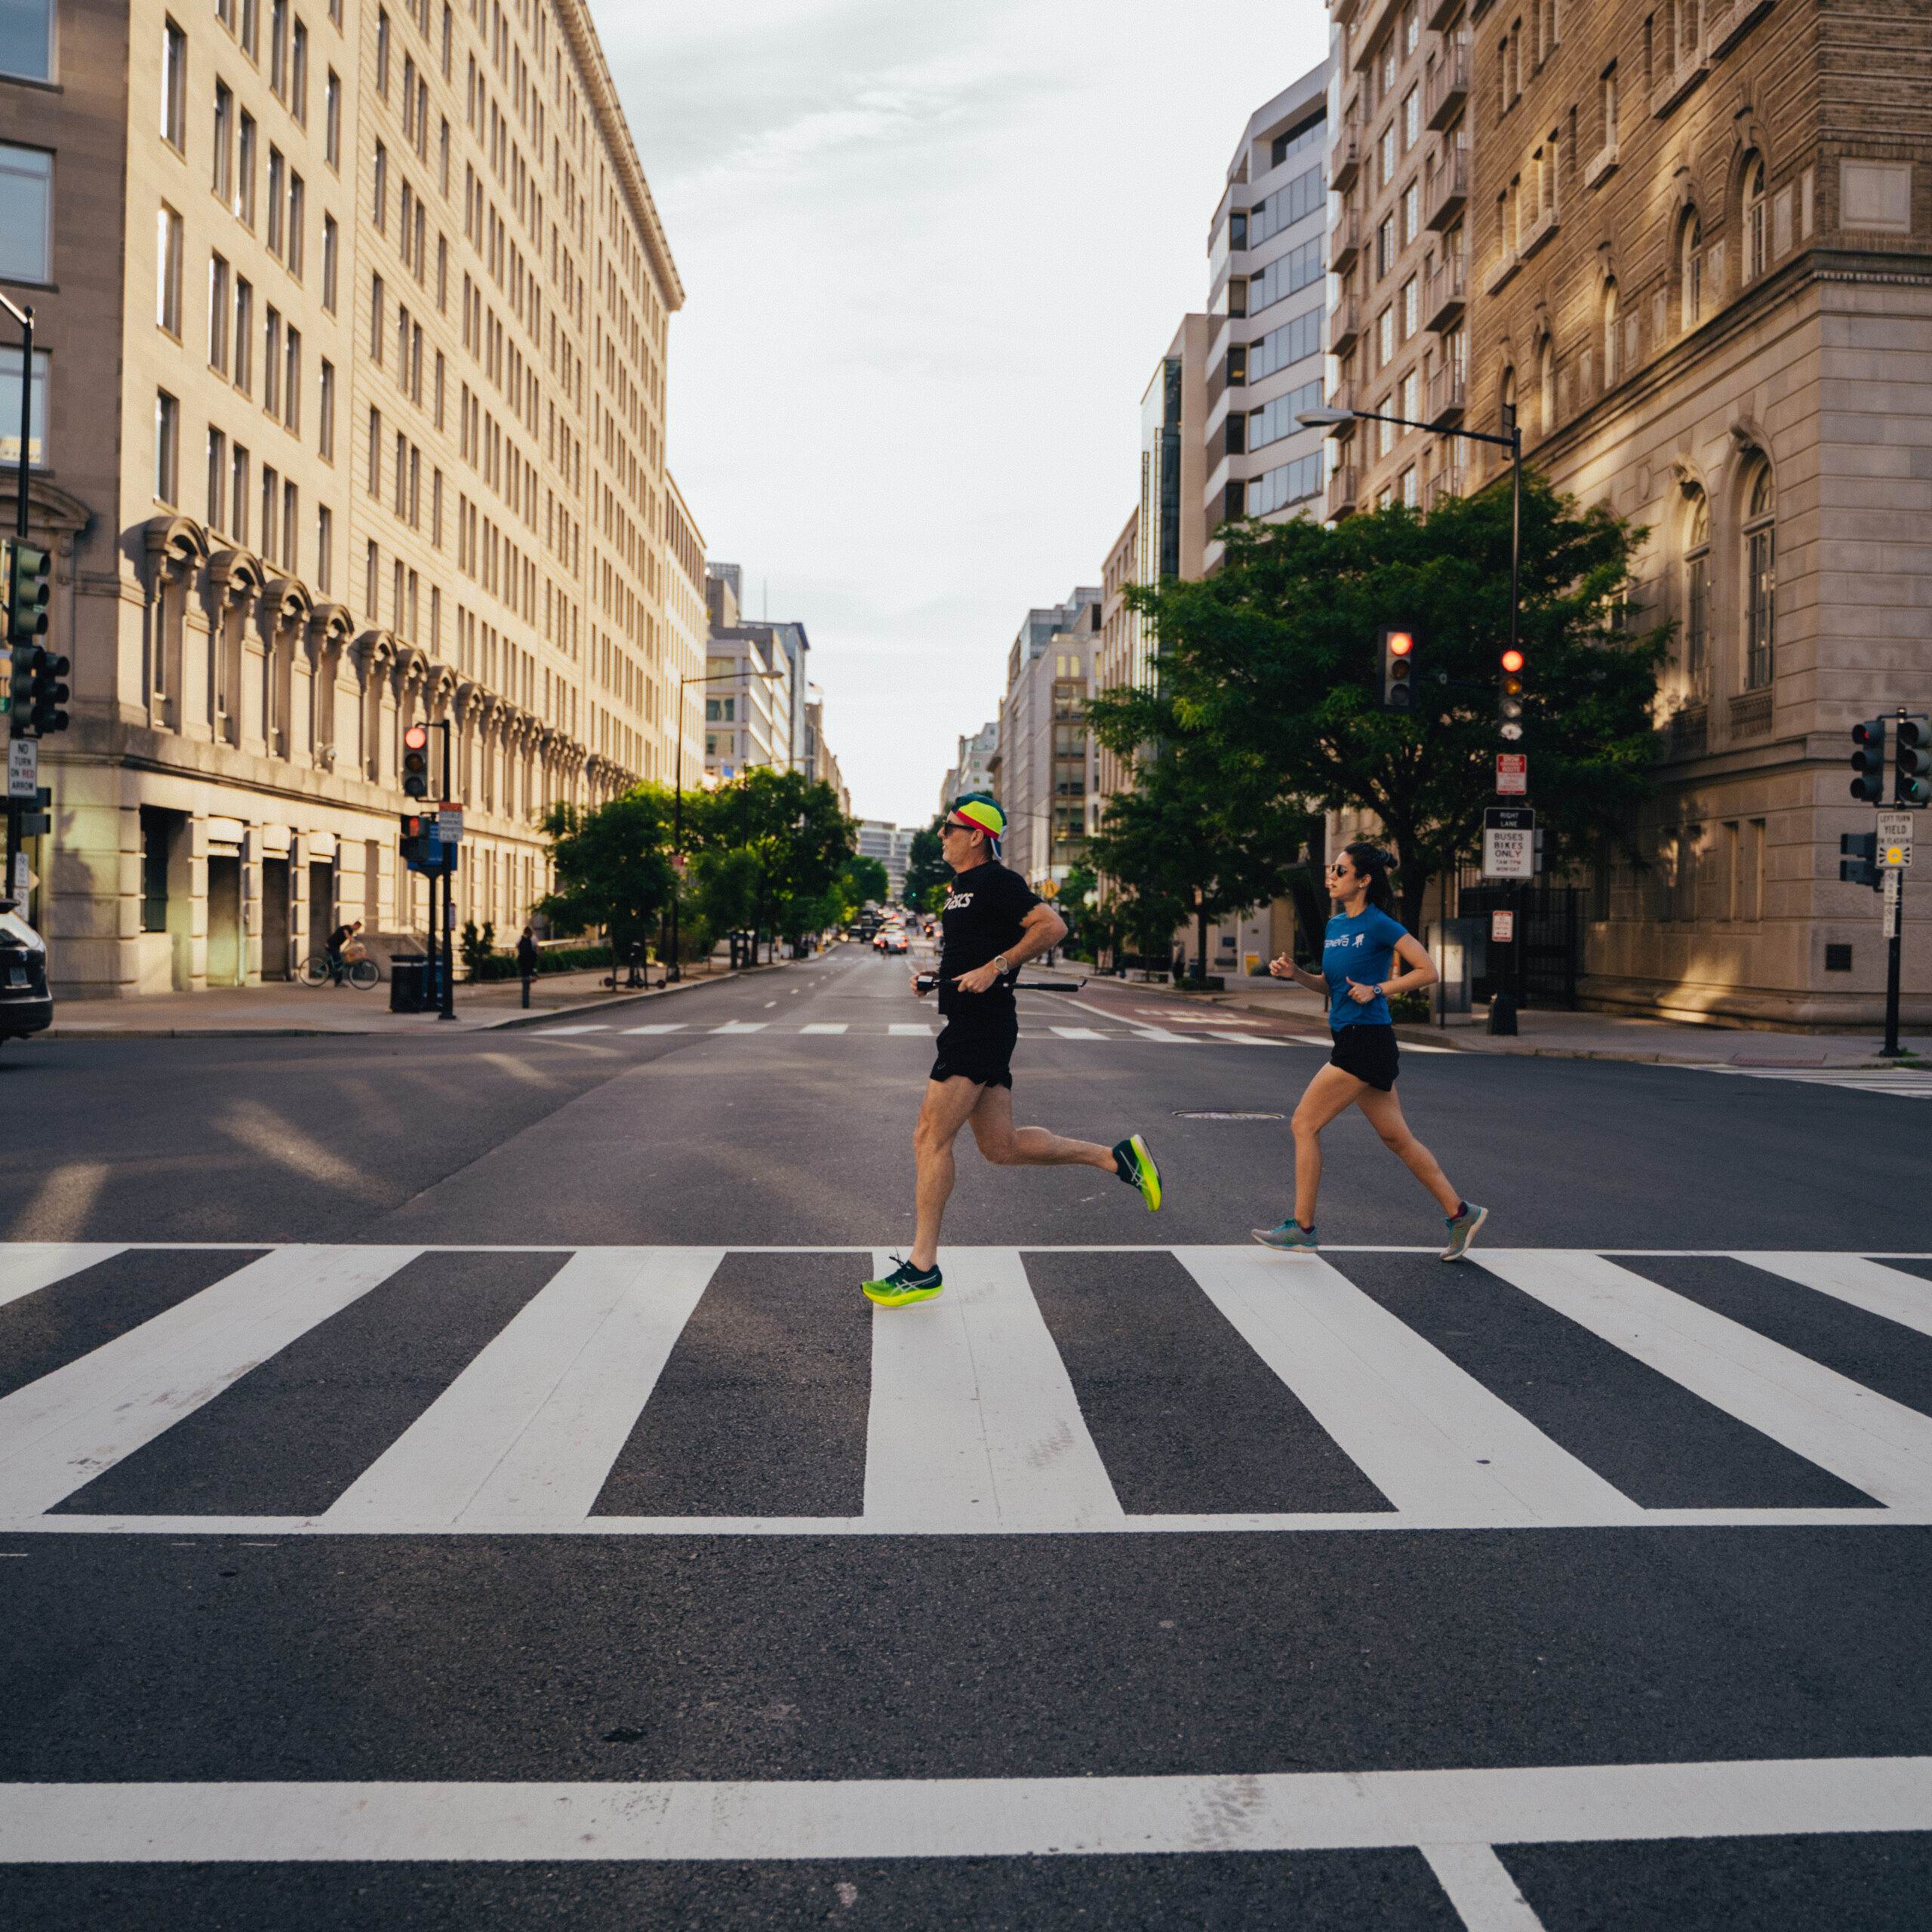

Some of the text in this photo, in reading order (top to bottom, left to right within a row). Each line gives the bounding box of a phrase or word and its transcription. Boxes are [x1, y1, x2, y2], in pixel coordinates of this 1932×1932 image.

[17, 743, 29, 755] NO
[14, 756, 31, 766] TURN
[11, 768, 35, 779] ON RED
[12, 780, 34, 791] ARROW
[1884, 825, 1907, 834] YIELD
